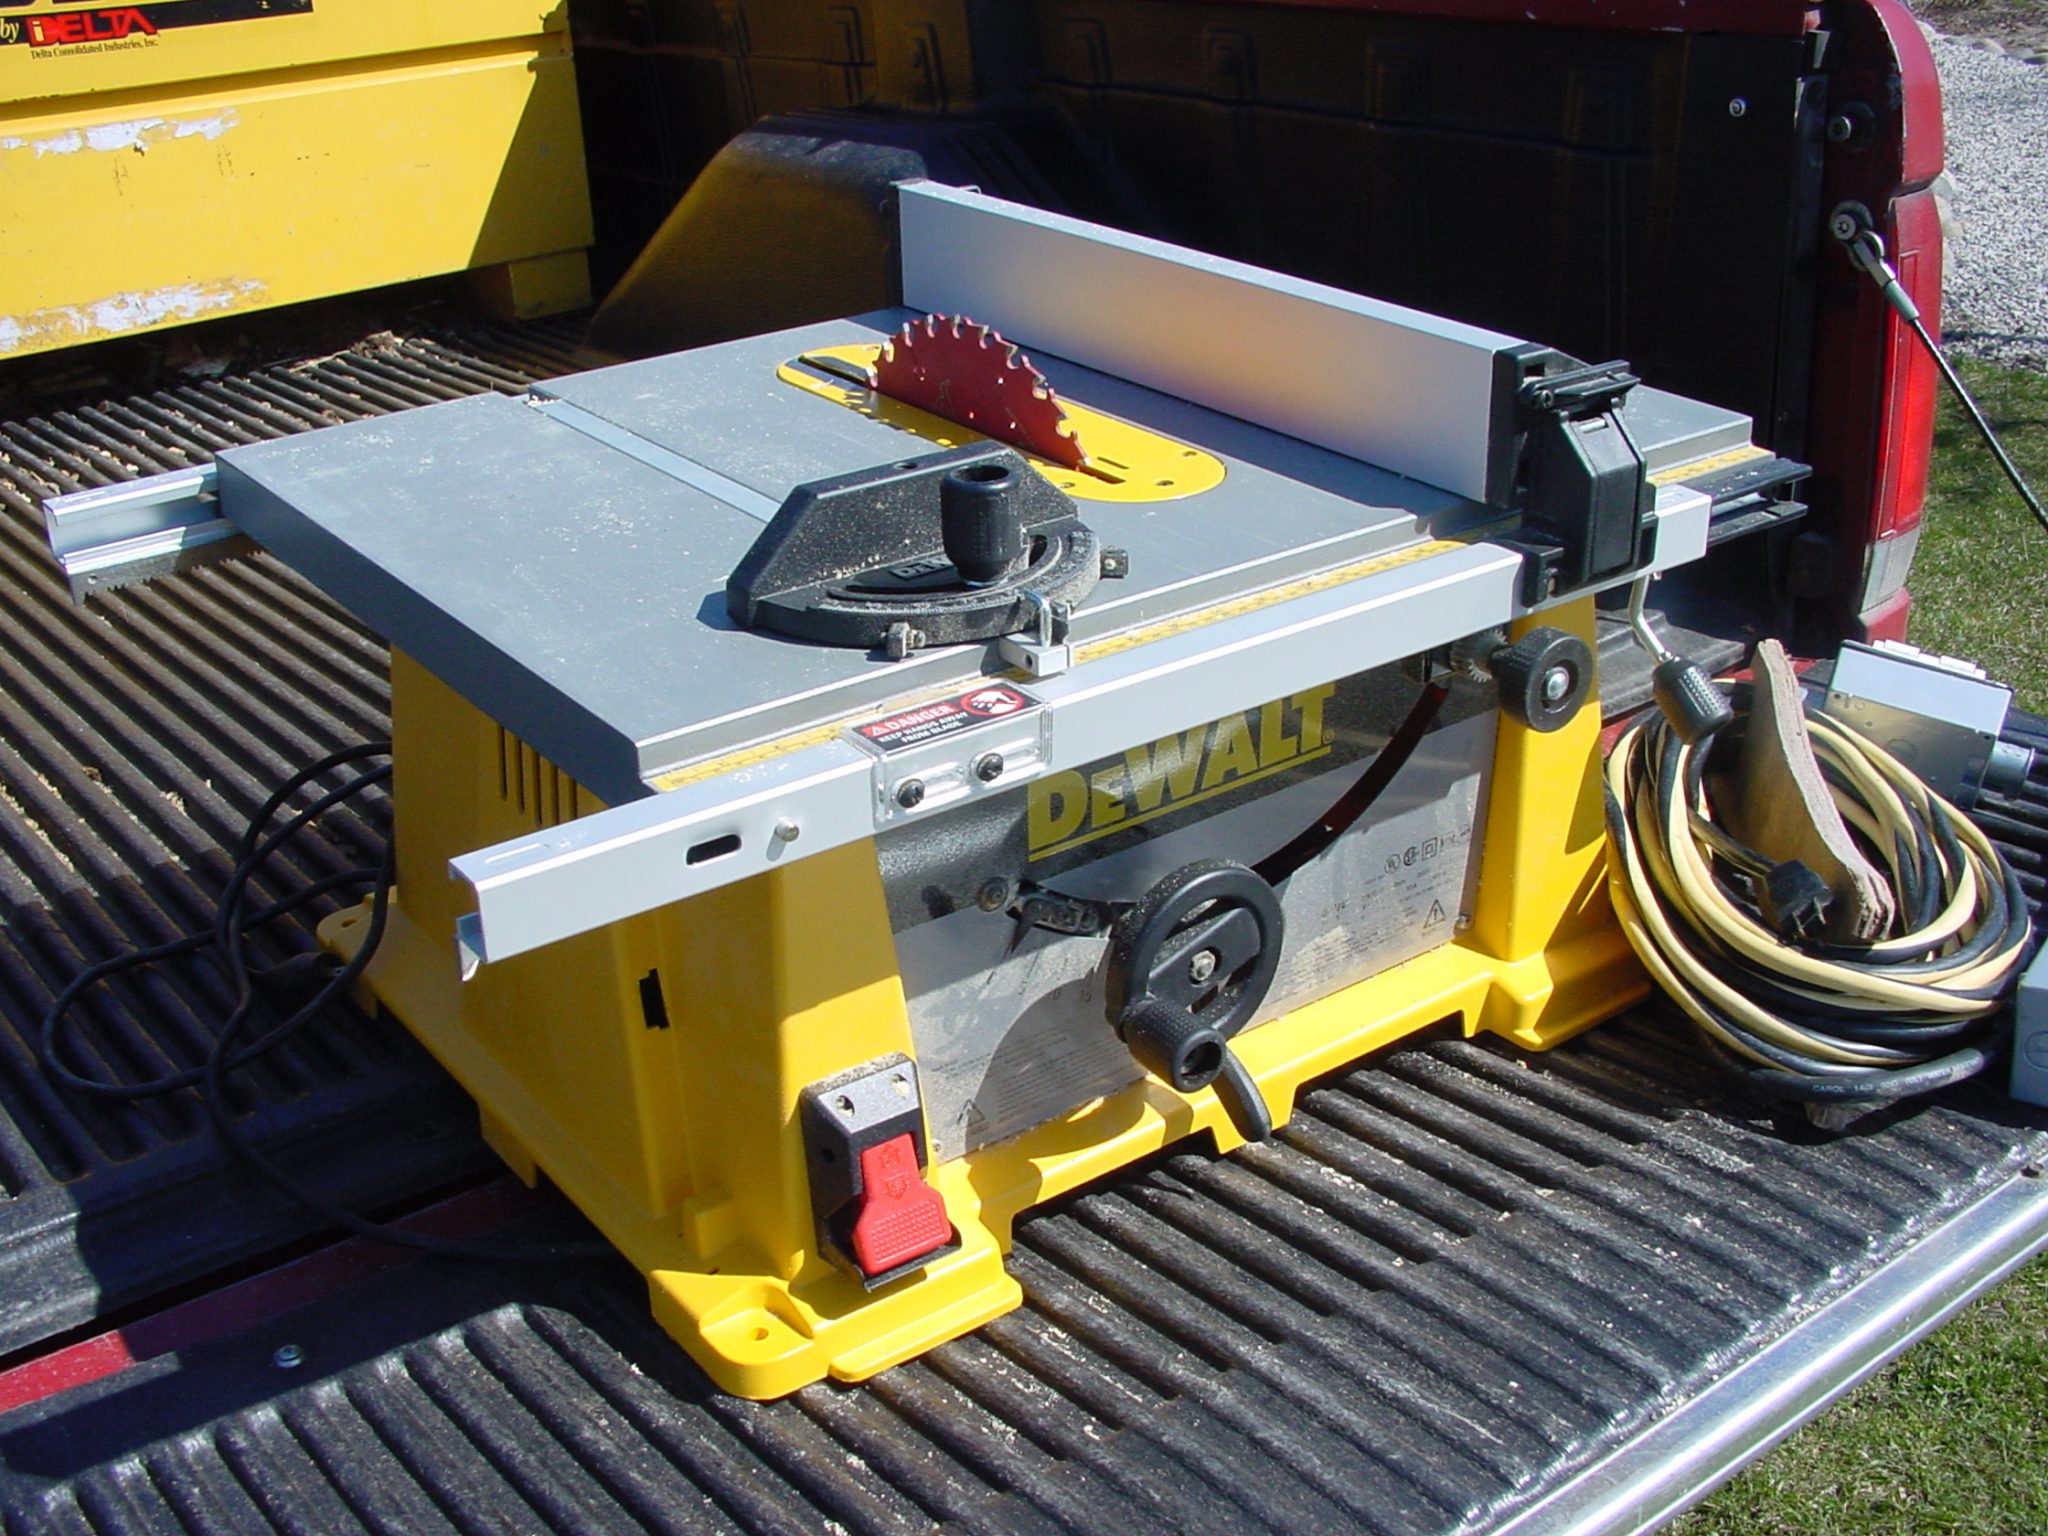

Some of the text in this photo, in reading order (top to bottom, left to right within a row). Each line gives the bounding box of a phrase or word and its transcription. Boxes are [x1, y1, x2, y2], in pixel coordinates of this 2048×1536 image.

[0, 17, 19, 43] by
[31, 38, 159, 59] Delta Consolidated Industries, Inc.
[878, 711, 969, 743] KEEP HANDS AWAY
[884, 704, 953, 729] DANGER
[901, 721, 963, 743] FROM BLADE
[1027, 683, 1335, 851] DEWALT
